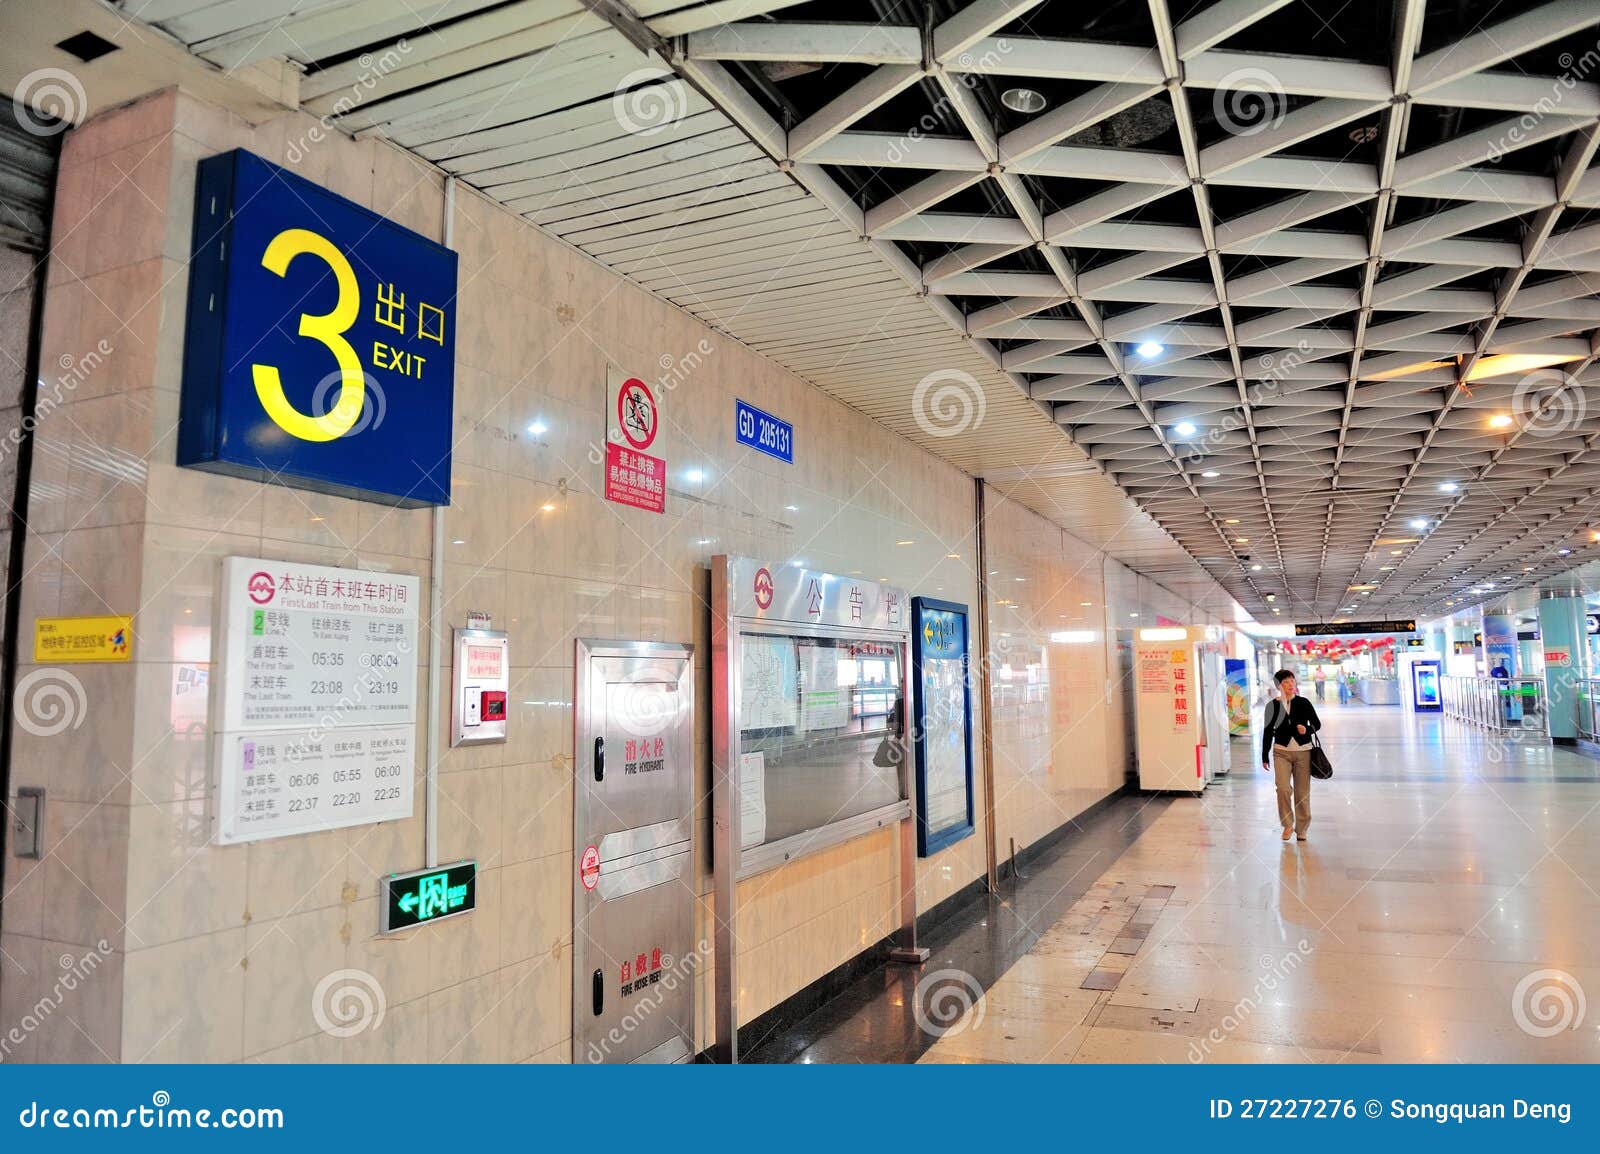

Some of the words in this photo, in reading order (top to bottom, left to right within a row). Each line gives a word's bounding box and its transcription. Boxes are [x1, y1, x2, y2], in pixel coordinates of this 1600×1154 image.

[375, 283, 444, 346] 出口
[252, 228, 365, 442] 3
[373, 341, 427, 379] EXIT
[739, 408, 754, 439] GD
[759, 418, 791, 455] 205131
[279, 572, 408, 604] 本站首末班车时间
[806, 577, 898, 625] 公告栏
[254, 616, 264, 631] 2
[268, 612, 289, 628] 号线
[252, 645, 289, 659] 首班车
[312, 652, 344, 666] 05:35
[370, 654, 398, 668] 06:04
[250, 675, 288, 690] 末班车
[311, 680, 343, 694] 23:08
[369, 681, 398, 694] 23:19
[625, 737, 664, 762] 消火栓
[333, 769, 361, 783] 05:55
[375, 765, 400, 778] 06:00
[625, 763, 637, 775] FIRE
[289, 774, 320, 788] 06:06
[332, 792, 361, 806] 22:20
[374, 788, 400, 801] 22:25
[288, 798, 318, 812] 22:37
